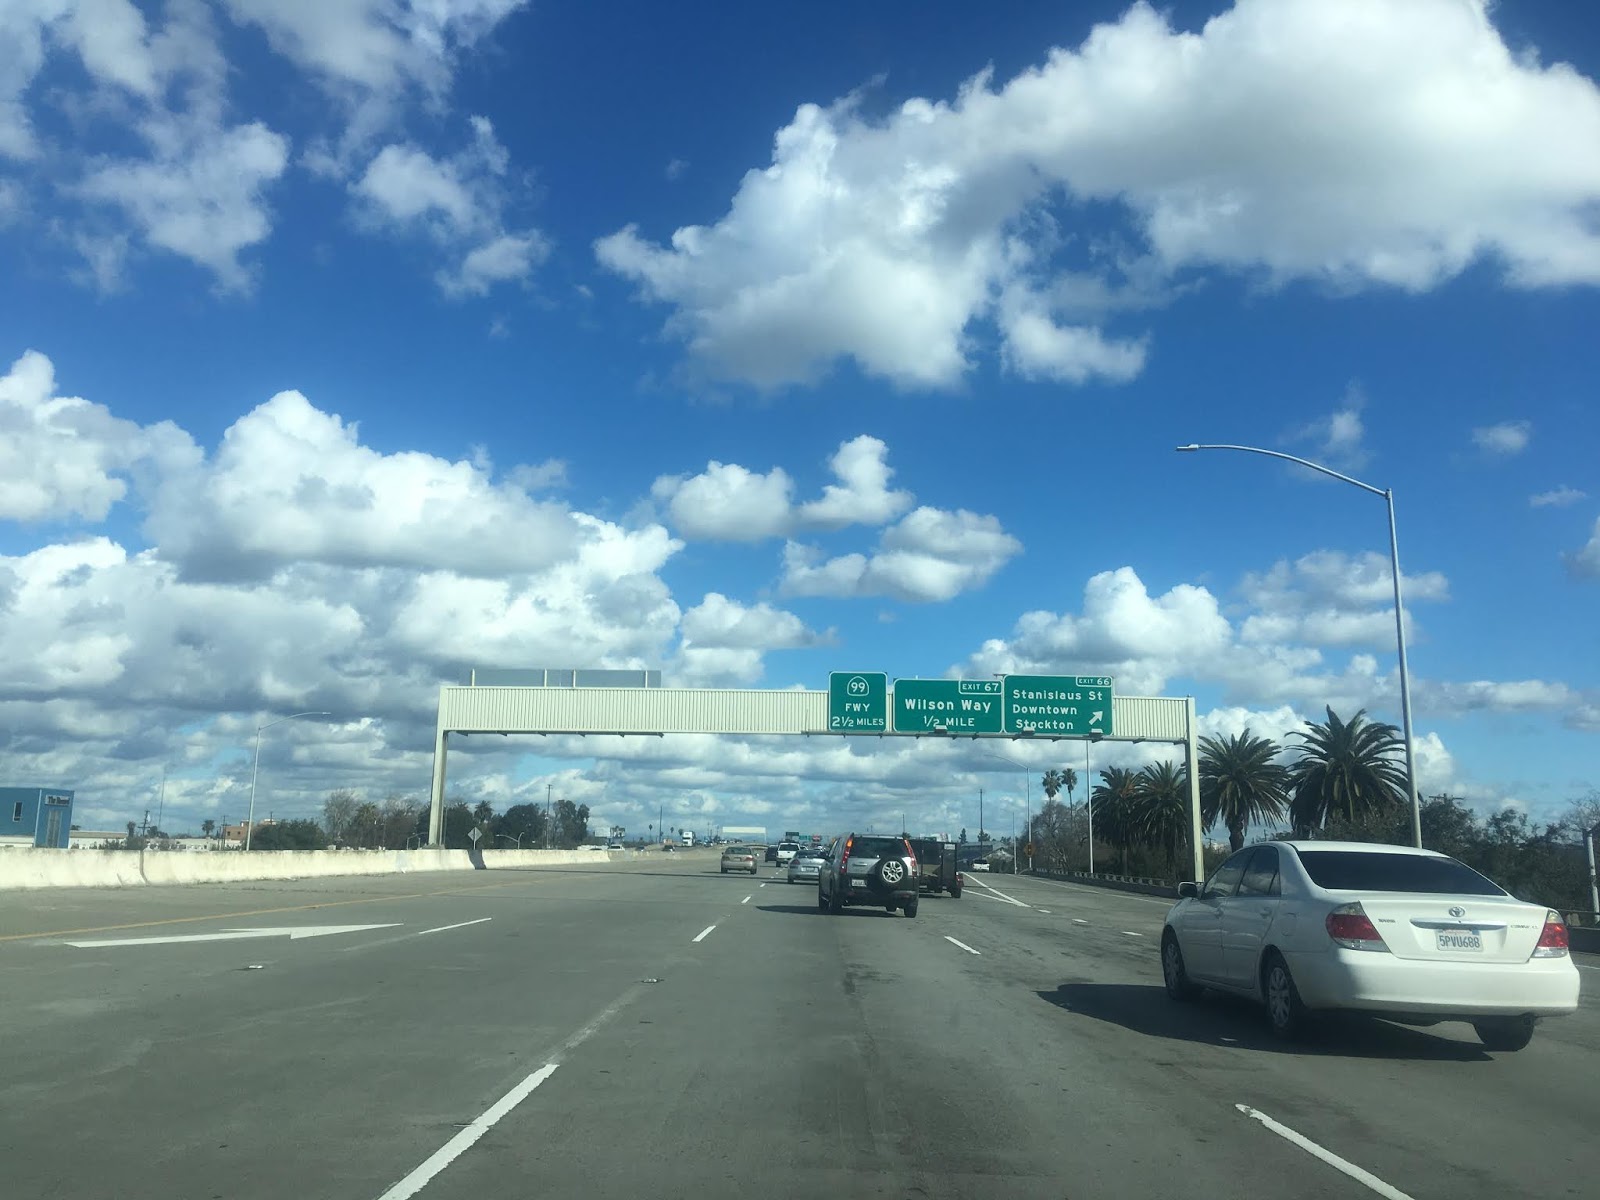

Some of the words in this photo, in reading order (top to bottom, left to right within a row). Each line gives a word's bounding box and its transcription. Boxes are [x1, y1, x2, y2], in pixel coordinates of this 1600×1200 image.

[1096, 677, 1110, 686] 66
[850, 682, 866, 692] 99
[962, 683, 981, 691] EXIT
[984, 682, 999, 692] 67
[1012, 689, 1082, 701] Stanislaus
[1088, 690, 1103, 701] St
[845, 703, 871, 712] FWY
[904, 698, 954, 711] Wilson
[961, 699, 991, 714] Way
[1012, 703, 1078, 715] Downtown
[856, 717, 885, 726] MILES
[945, 717, 975, 727] MILE
[1015, 718, 1074, 730] Stockton
[1439, 934, 1481, 948] 5PVU688
